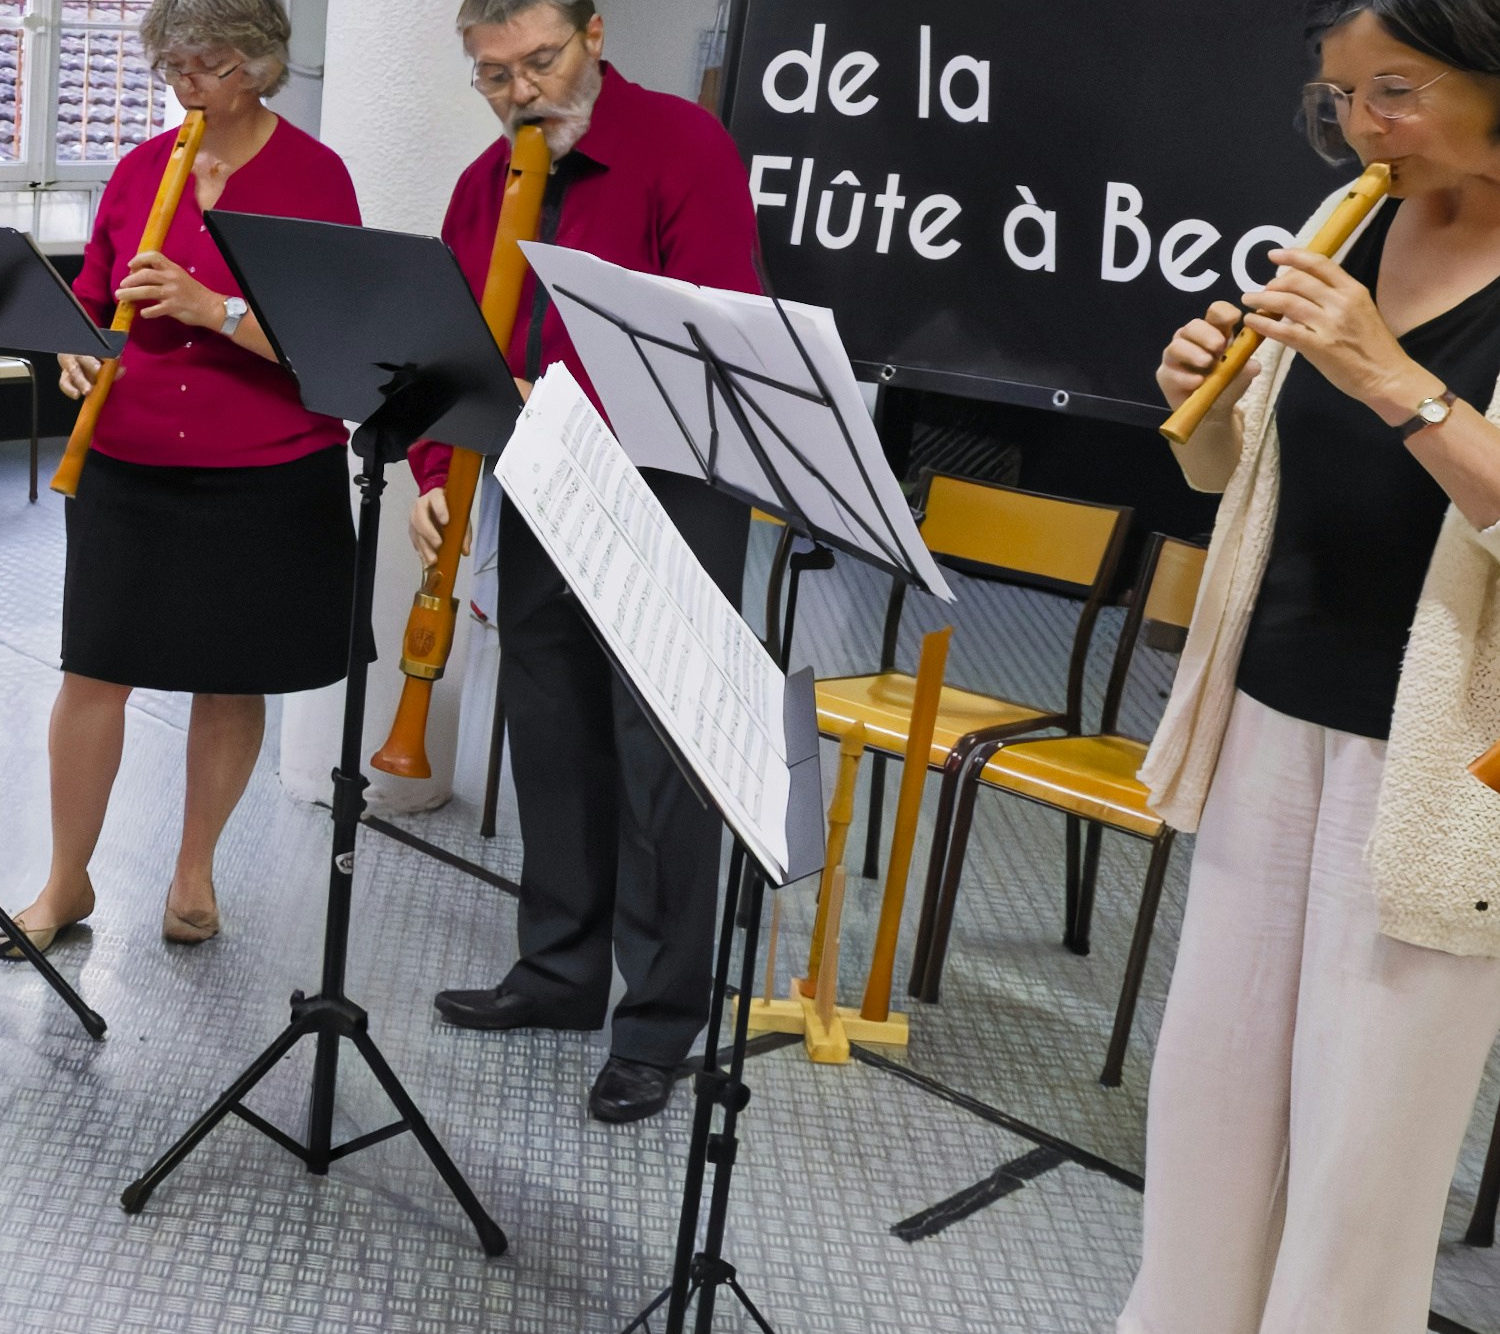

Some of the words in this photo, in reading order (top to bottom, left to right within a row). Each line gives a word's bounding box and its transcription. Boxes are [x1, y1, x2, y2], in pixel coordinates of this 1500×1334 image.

[761, 22, 881, 117] de
[917, 23, 991, 124] la
[749, 154, 963, 261] Flûte
[1002, 183, 1057, 274] à
